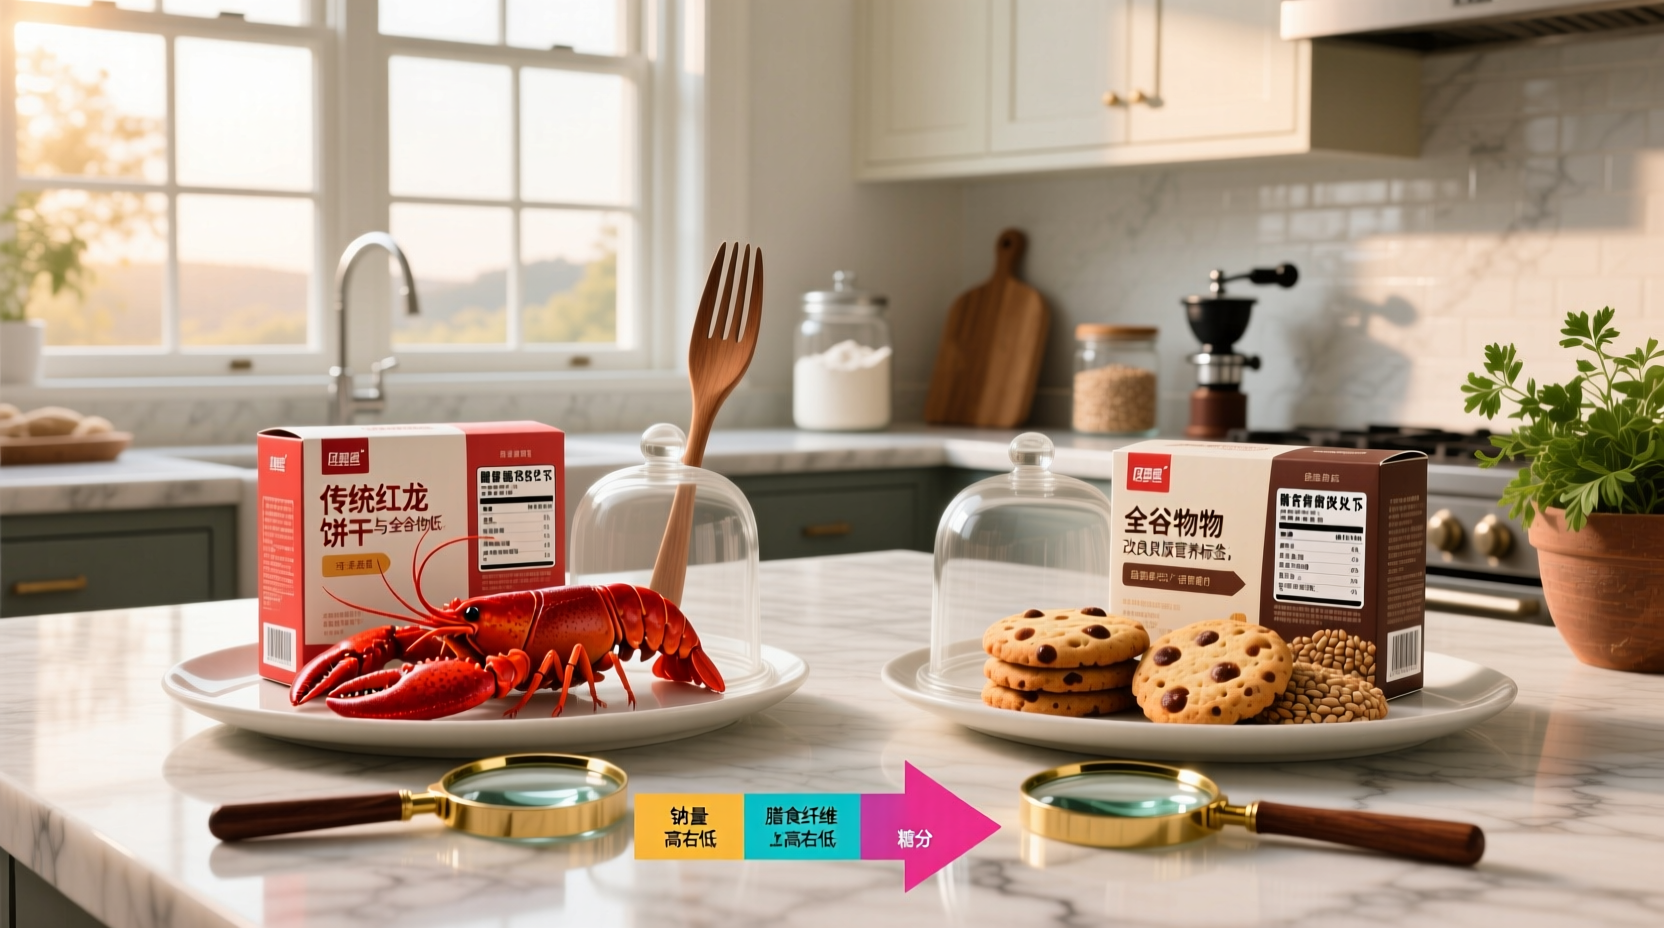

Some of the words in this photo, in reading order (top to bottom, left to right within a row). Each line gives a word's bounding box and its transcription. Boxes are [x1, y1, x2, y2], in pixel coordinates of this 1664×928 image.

[320, 482, 429, 515] 传统红龙
[1124, 505, 1224, 538] 全谷物物
